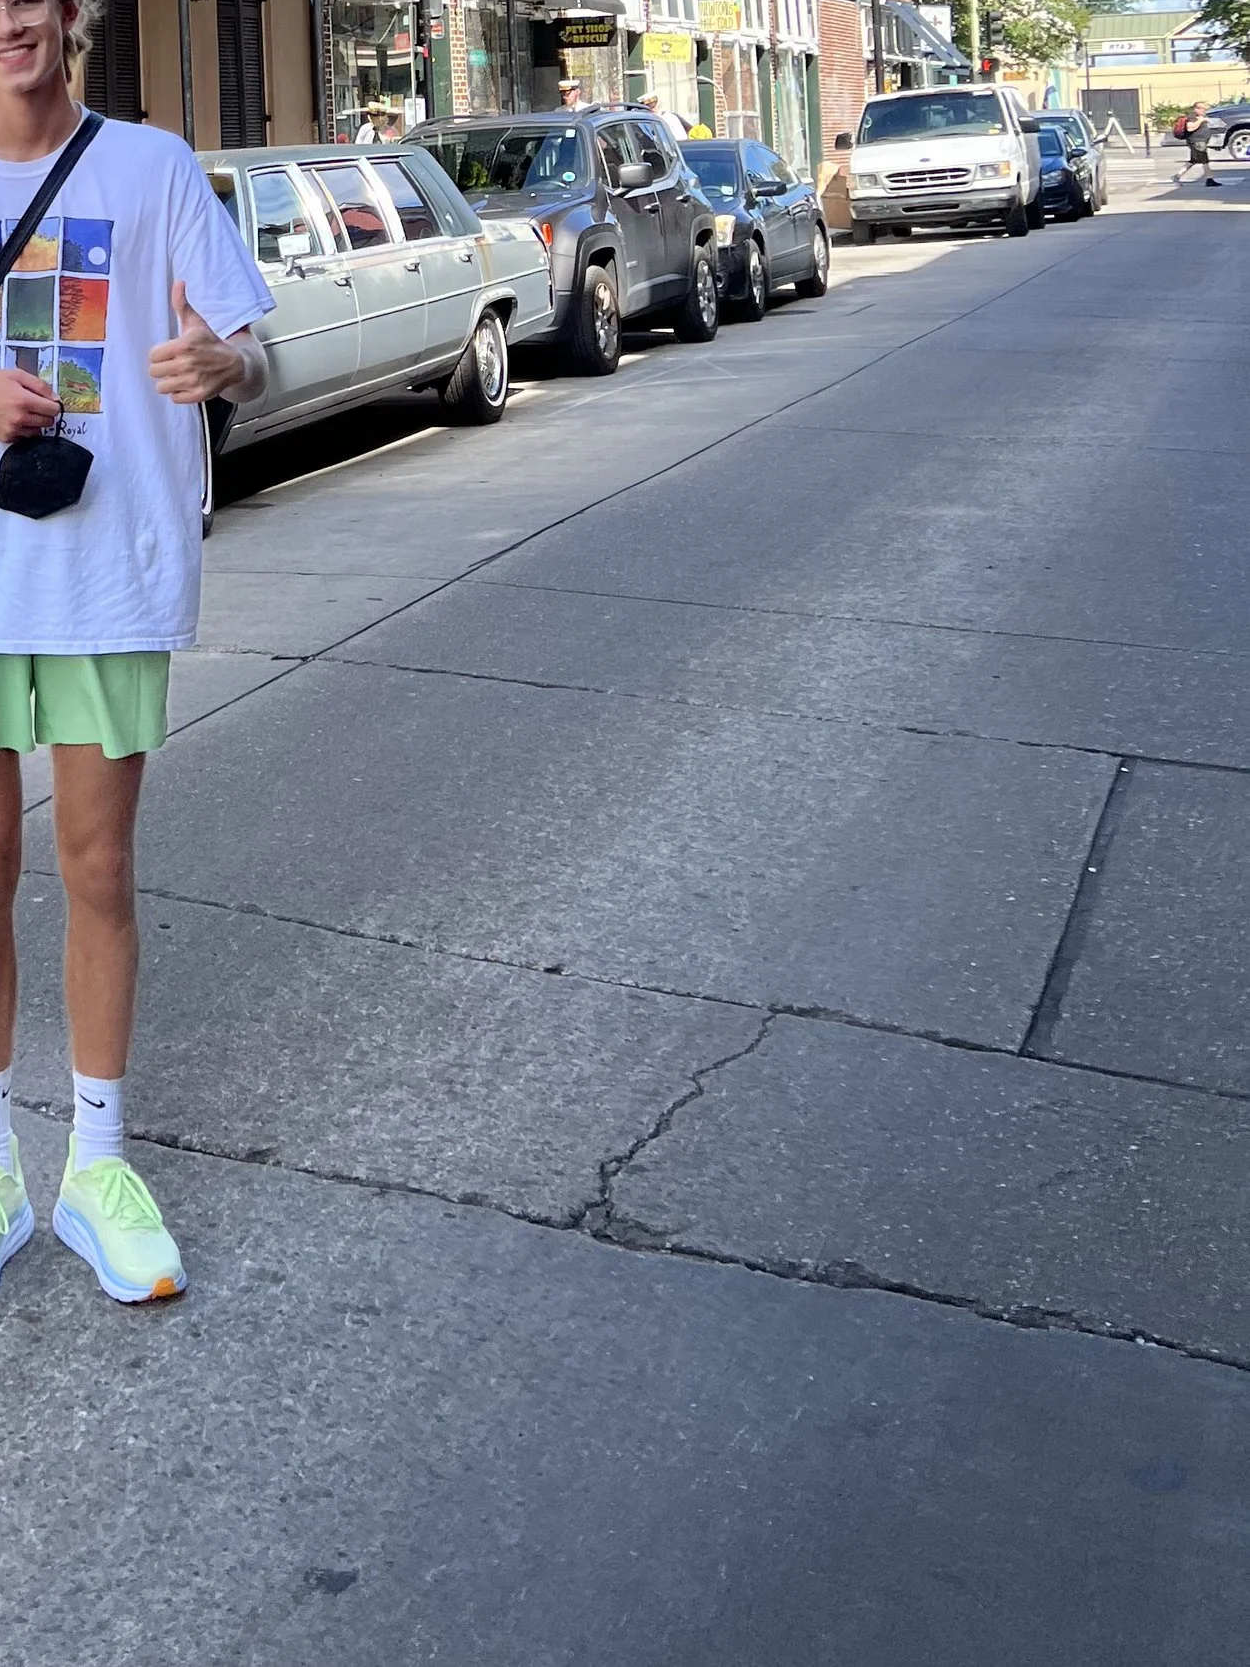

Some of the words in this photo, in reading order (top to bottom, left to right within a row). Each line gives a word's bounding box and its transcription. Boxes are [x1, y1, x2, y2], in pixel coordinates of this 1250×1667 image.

[565, 25, 584, 34] PET
[585, 24, 612, 33] SHOP
[572, 33, 609, 43] RESCUE
